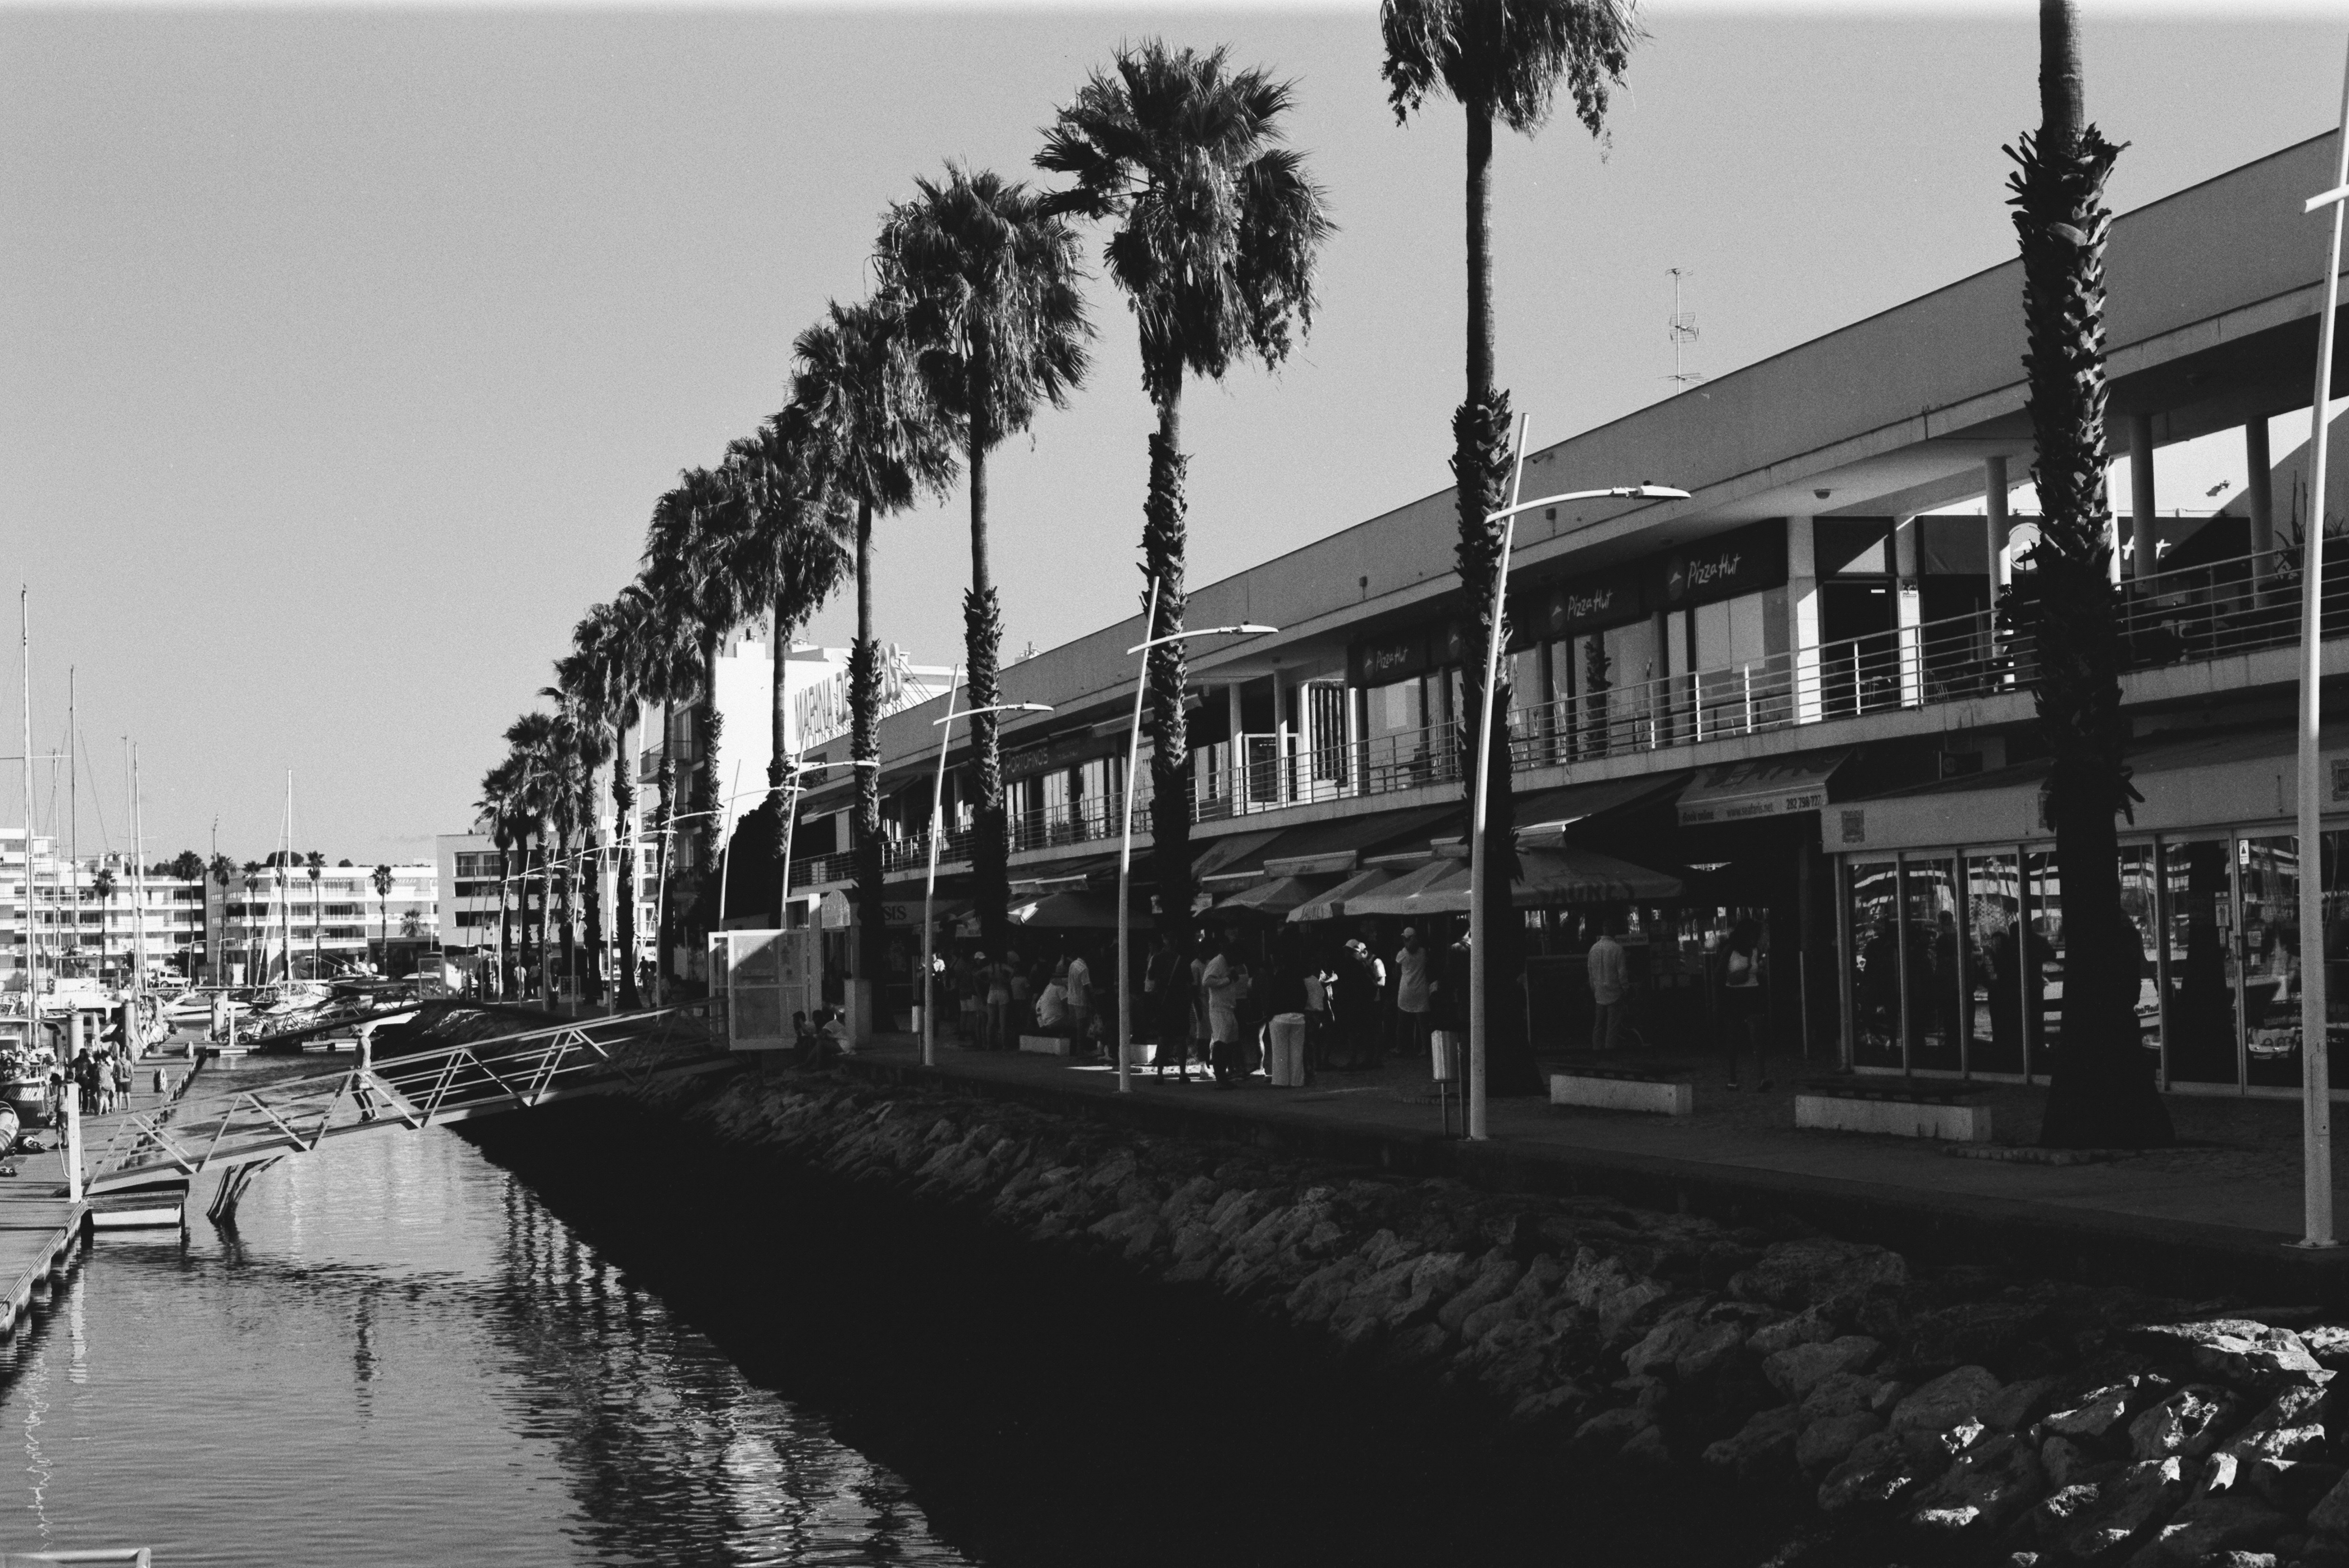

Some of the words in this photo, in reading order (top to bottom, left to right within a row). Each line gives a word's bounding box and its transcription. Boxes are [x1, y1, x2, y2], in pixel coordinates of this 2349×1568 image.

[1687, 560, 1717, 589] Pizza
[1718, 553, 1742, 579] Hut
[1567, 594, 1592, 621] Pizza
[1593, 588, 1613, 612] Hut
[1376, 650, 1394, 671] Pizza
[1394, 646, 1409, 666] Hut
[1698, 809, 1714, 821] online
[1726, 803, 1773, 817] www.seafaris.net
[1786, 798, 1797, 810] 282
